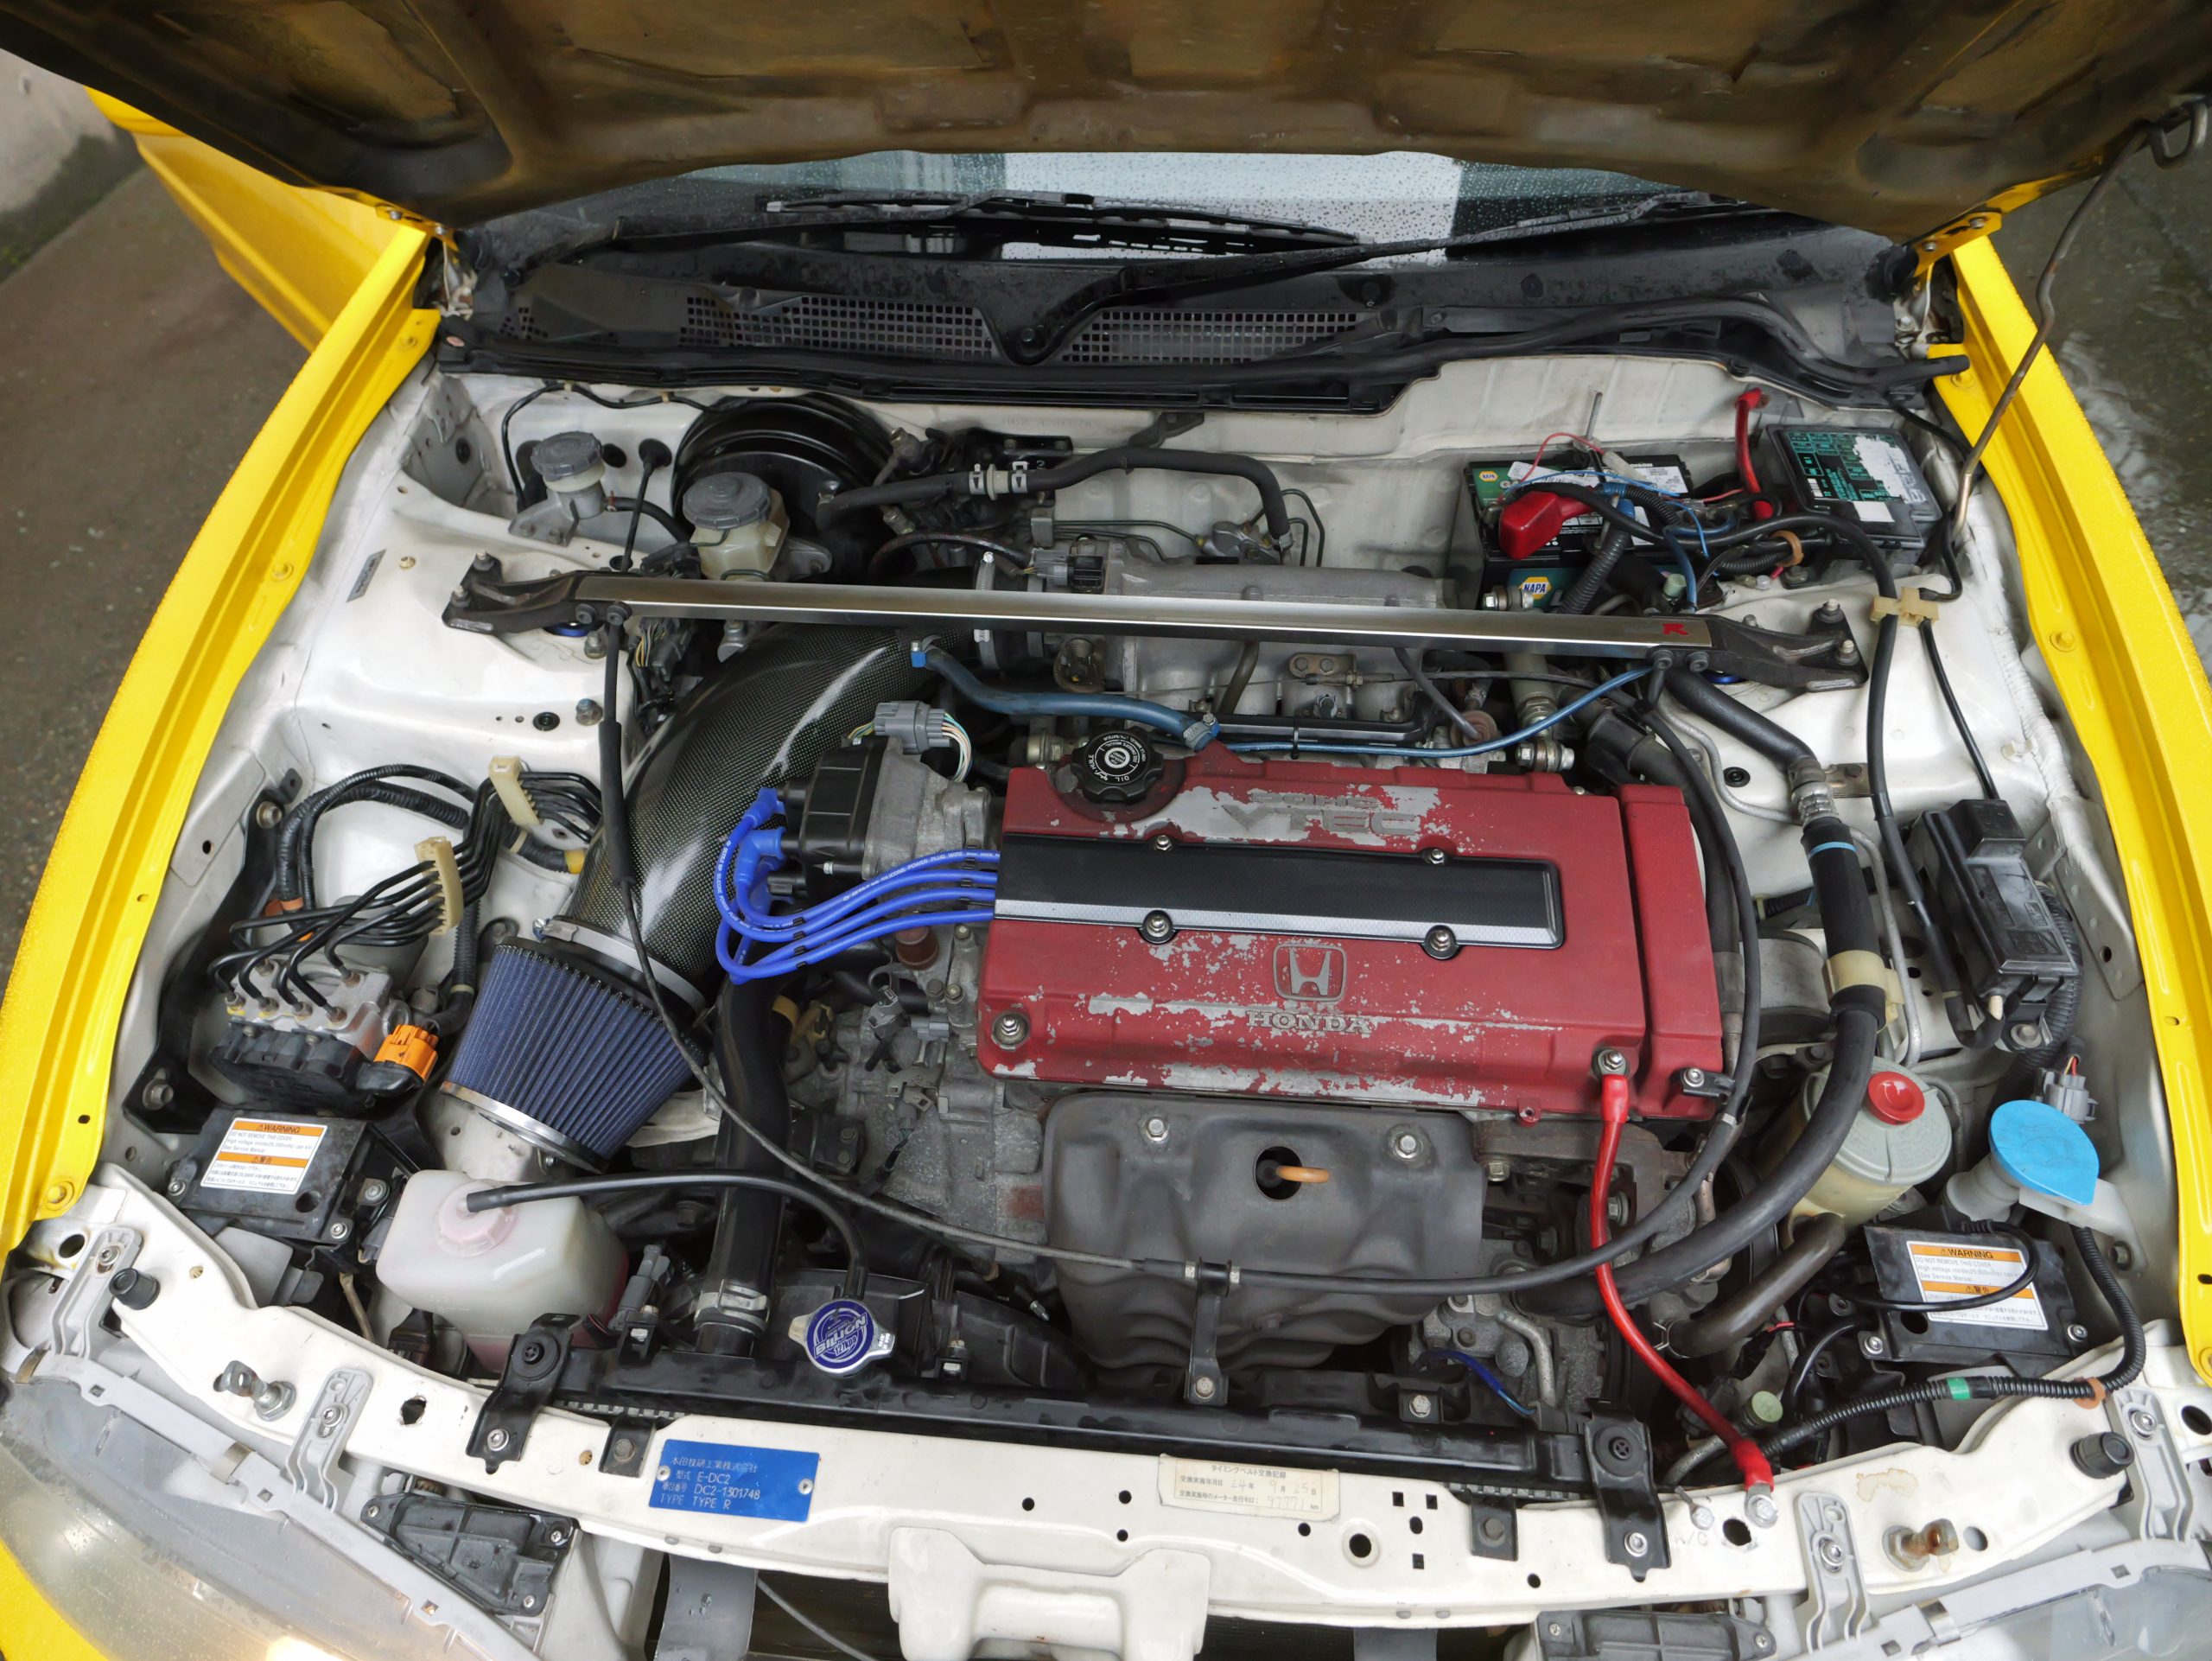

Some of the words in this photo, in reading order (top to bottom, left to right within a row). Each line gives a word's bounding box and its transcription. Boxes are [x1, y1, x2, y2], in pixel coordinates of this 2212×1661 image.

[1523, 583, 1546, 594] NAPA
[1088, 754, 1096, 771] HUILE
[1222, 804, 1418, 836] VTEC
[906, 859, 928, 870] POWER
[1246, 1010, 1372, 1034] HONDA
[264, 1123, 301, 1134] WARNING
[258, 1155, 273, 1164] 警告
[1948, 1248, 1994, 1259] WARNING
[1974, 1285, 1990, 1295] 警告
[677, 1470, 691, 1480] 型式
[696, 1472, 731, 1485] E-DC2
[1211, 1465, 1287, 1479] タイミングベルト交換記録
[662, 1481, 687, 1492] 車台番号
[694, 1484, 760, 1500] DC2-1301748
[660, 1493, 684, 1505] TYPE
[693, 1496, 717, 1509] TYPE
[723, 1499, 731, 1510] R
